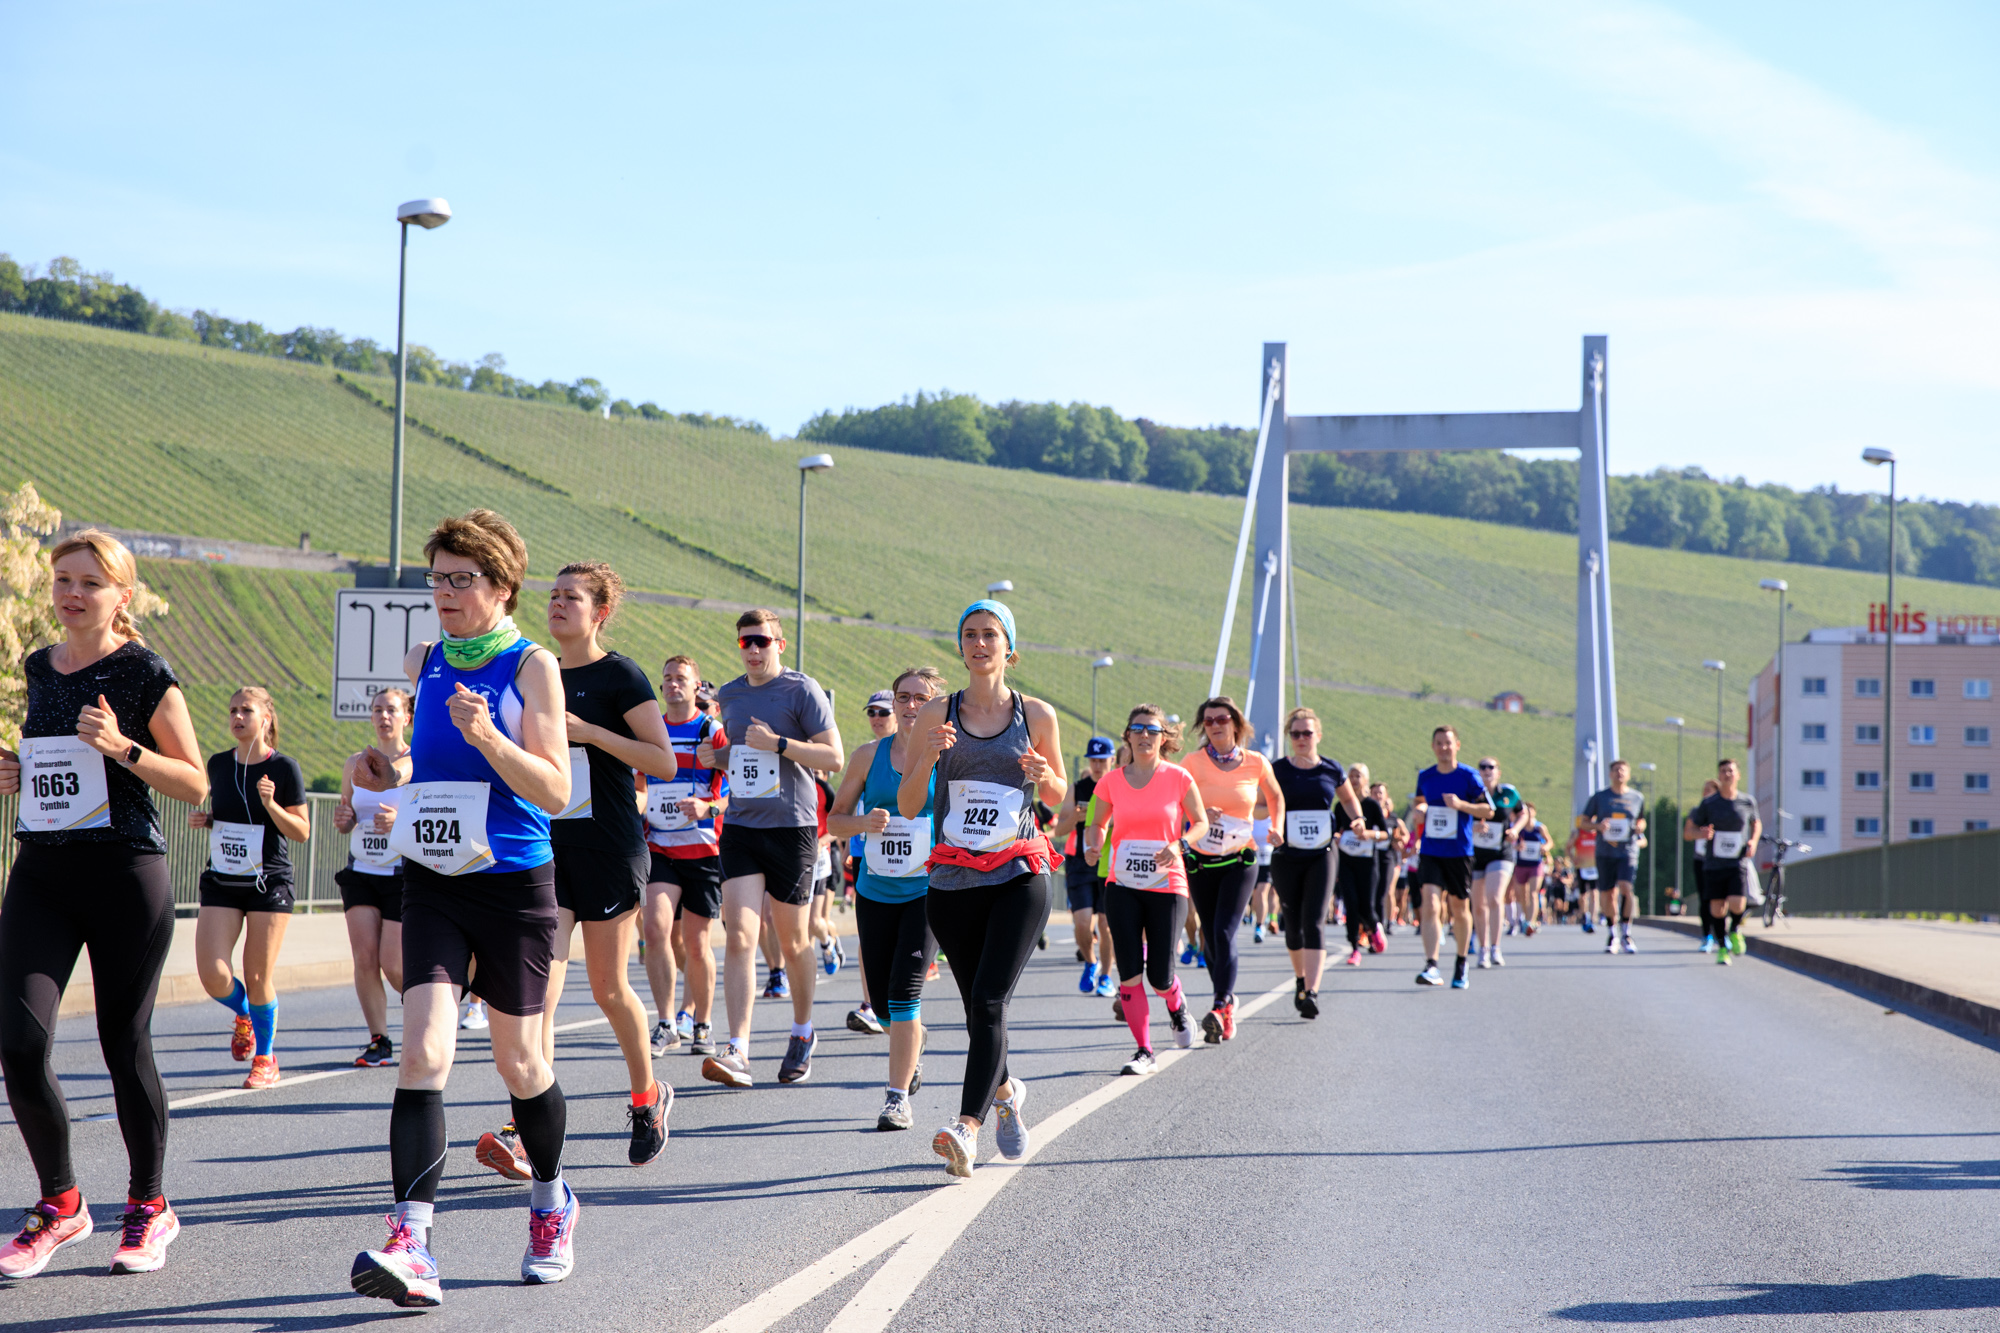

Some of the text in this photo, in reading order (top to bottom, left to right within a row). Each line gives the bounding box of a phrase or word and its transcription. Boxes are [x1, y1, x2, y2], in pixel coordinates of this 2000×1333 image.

[1869, 602, 1927, 634] ibis
[743, 765, 758, 779] 55
[31, 772, 80, 798] 1663
[40, 800, 70, 811] Cynthia
[963, 807, 999, 827] 1242
[412, 819, 461, 844] 1324
[962, 827, 991, 836] Christina
[1209, 827, 1224, 840] 144
[1298, 825, 1319, 836] 1314
[220, 842, 247, 858] 1555
[362, 837, 388, 850] 1200
[880, 840, 912, 856] 1015
[422, 847, 454, 858] Irmgard
[1126, 858, 1157, 873] 2565
